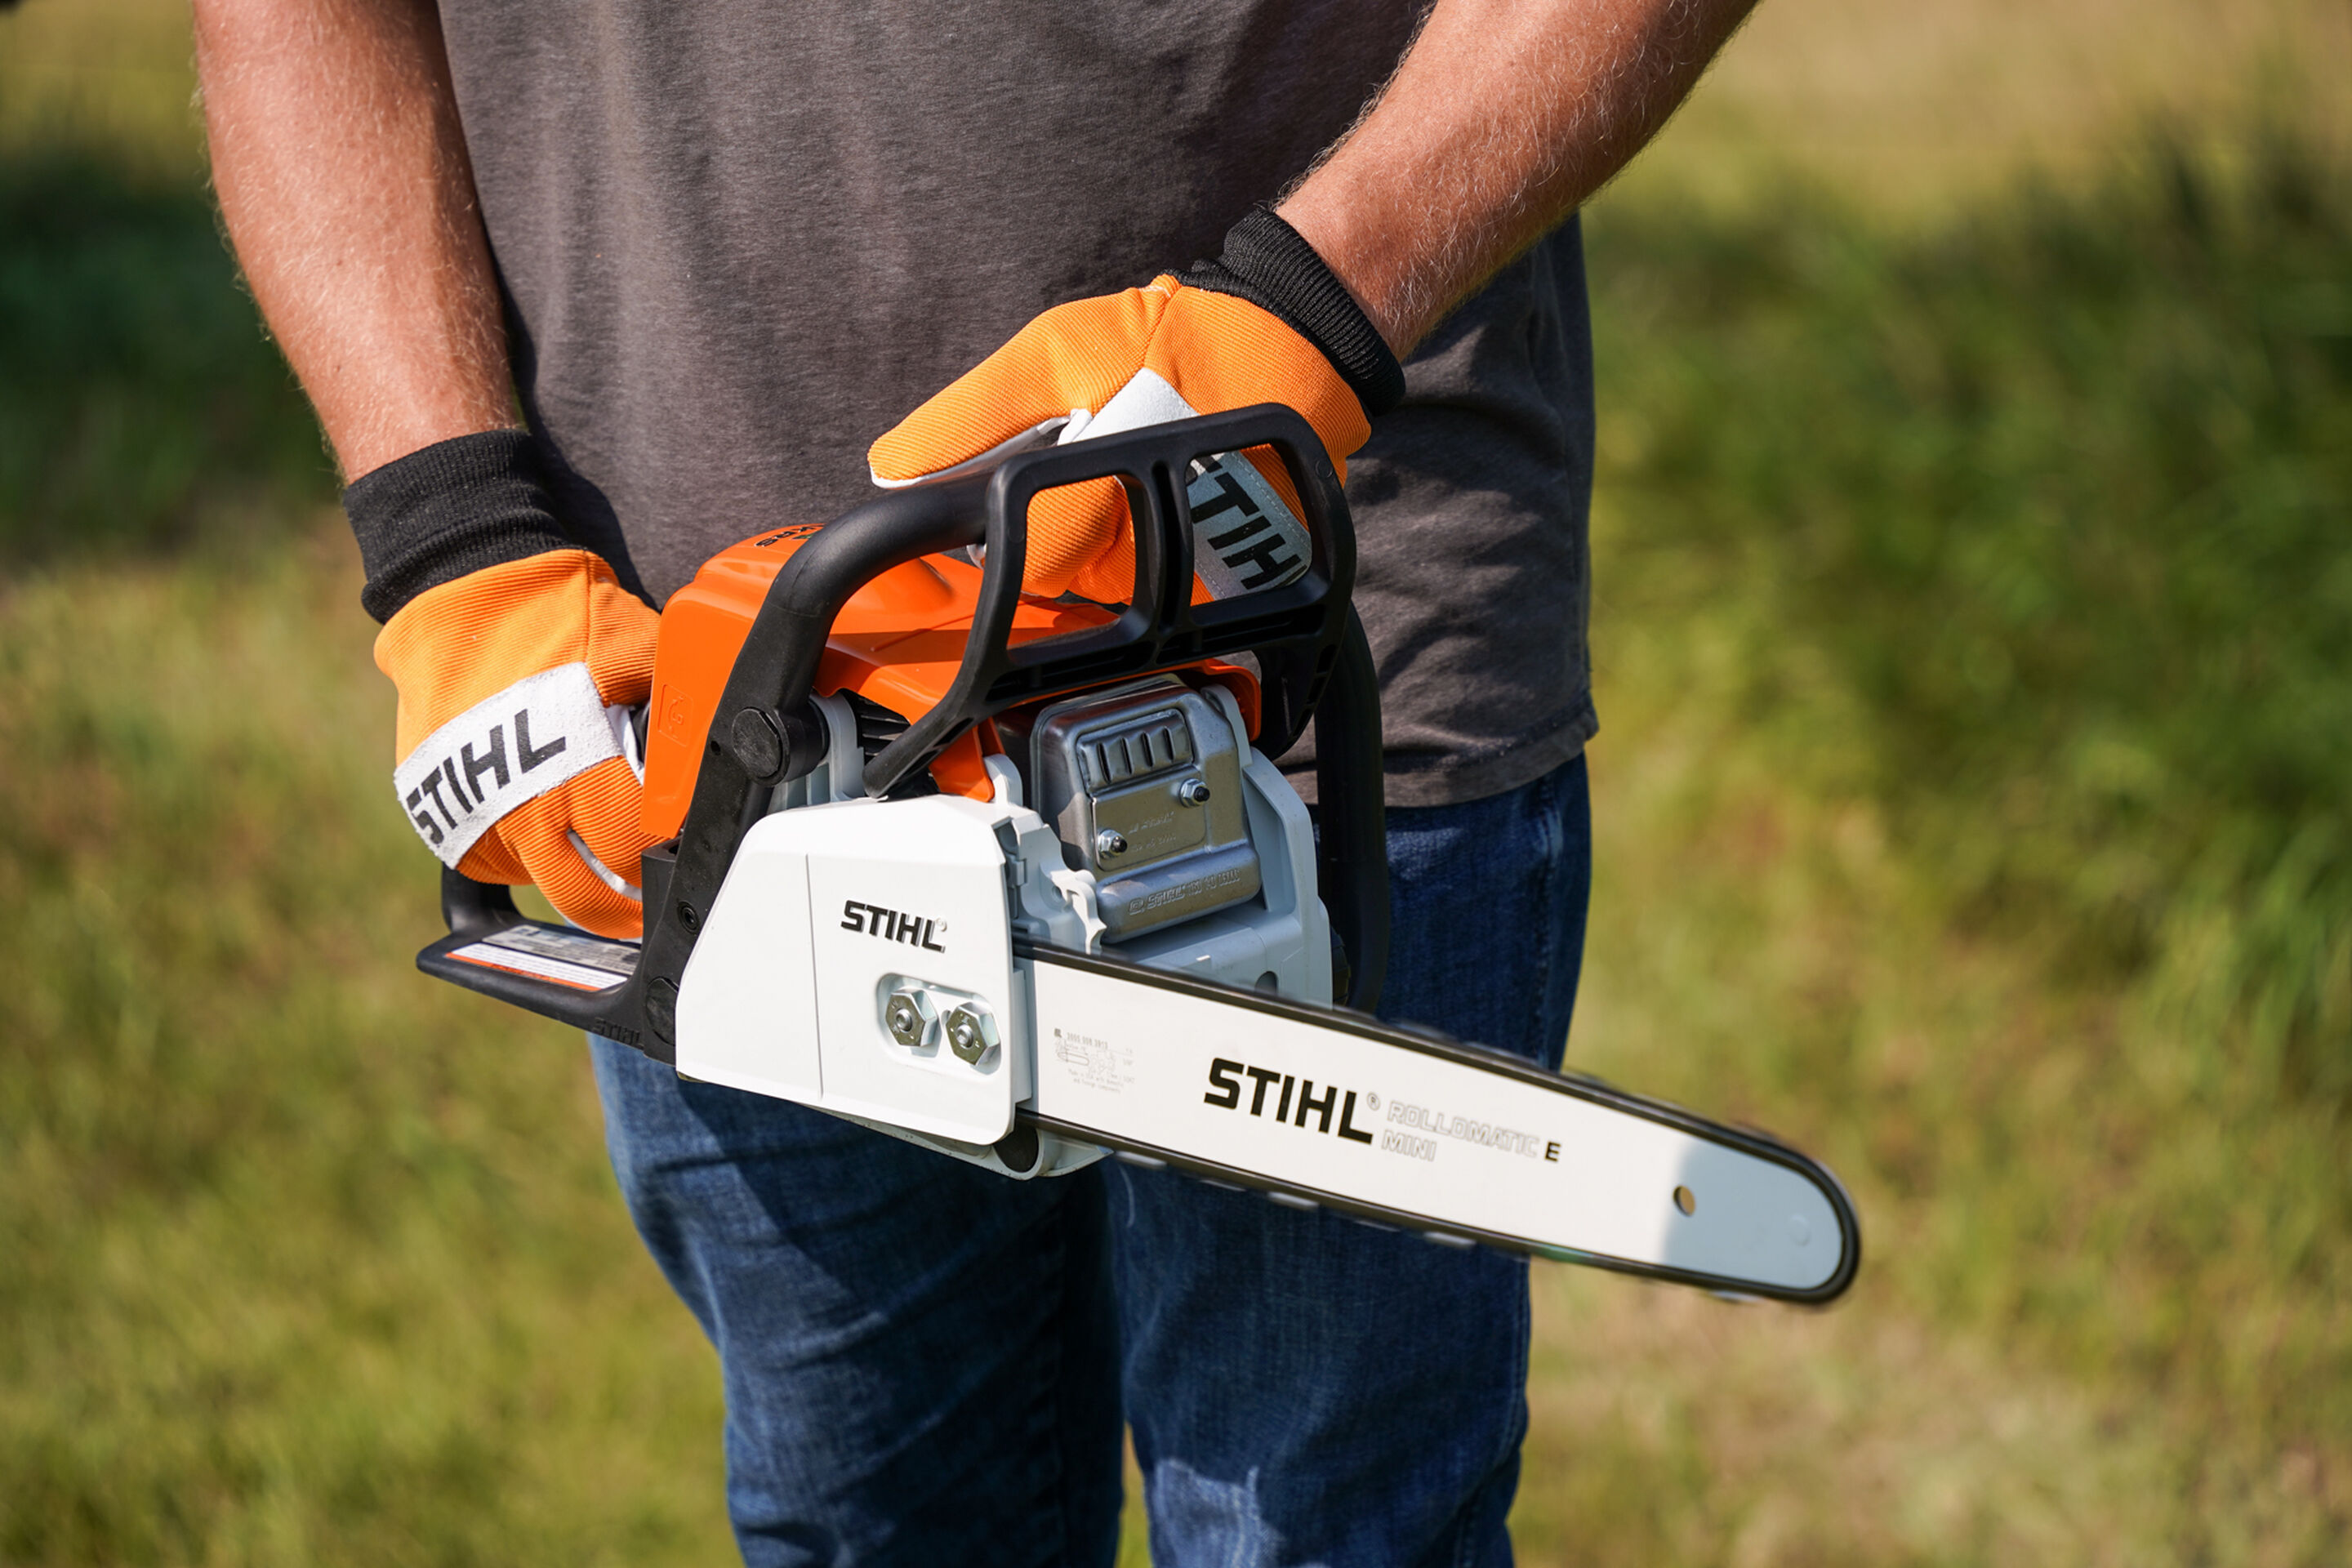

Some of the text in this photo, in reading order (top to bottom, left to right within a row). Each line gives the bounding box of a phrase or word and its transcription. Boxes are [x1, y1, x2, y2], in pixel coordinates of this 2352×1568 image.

[1186, 456, 1307, 590] TIH
[406, 708, 566, 844] STIHL
[840, 899, 946, 954] STIHL
[1204, 1058, 1374, 1144] STIHL
[1387, 1100, 1561, 1163] ROLLOMATIC E
[1381, 1129, 1437, 1161] MINI
